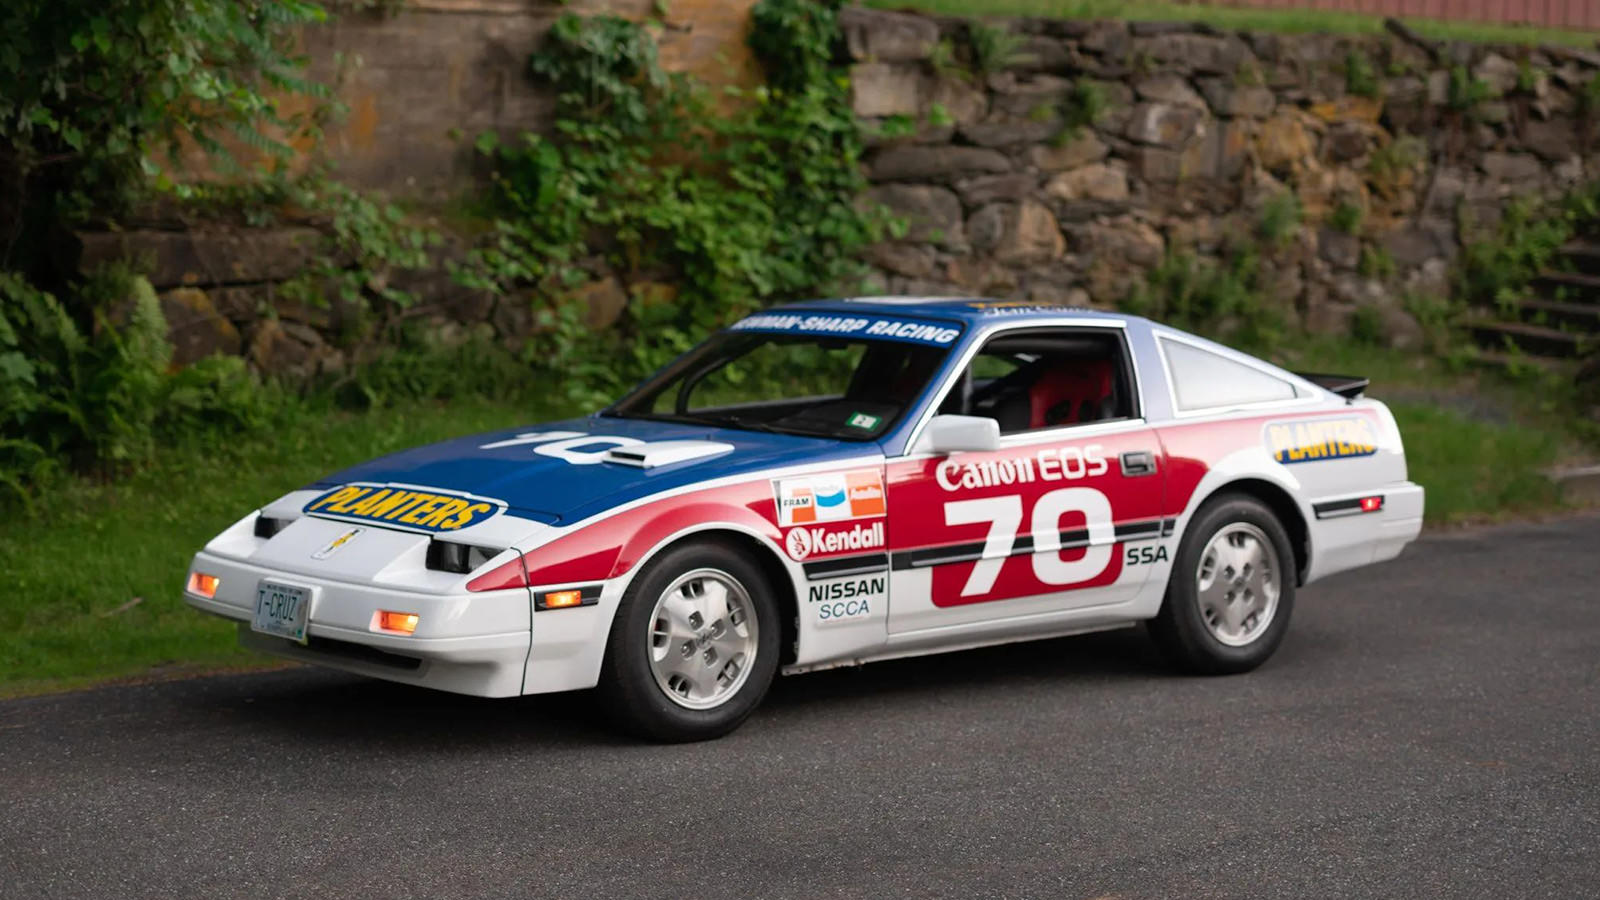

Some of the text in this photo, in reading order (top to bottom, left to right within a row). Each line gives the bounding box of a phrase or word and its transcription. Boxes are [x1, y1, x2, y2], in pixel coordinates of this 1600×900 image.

[865, 320, 960, 343] RACING
[1269, 419, 1375, 462] PLANTERS
[936, 445, 1109, 492] Canon EOS
[310, 485, 492, 530] PLANTERS
[783, 497, 809, 507] FRAM
[811, 522, 885, 554] Kendall
[943, 486, 1116, 598] 70
[1126, 545, 1169, 566] SSA
[257, 589, 298, 622] T-CRUZ
[809, 577, 885, 603] NISSAN
[819, 600, 870, 620] SCCA
